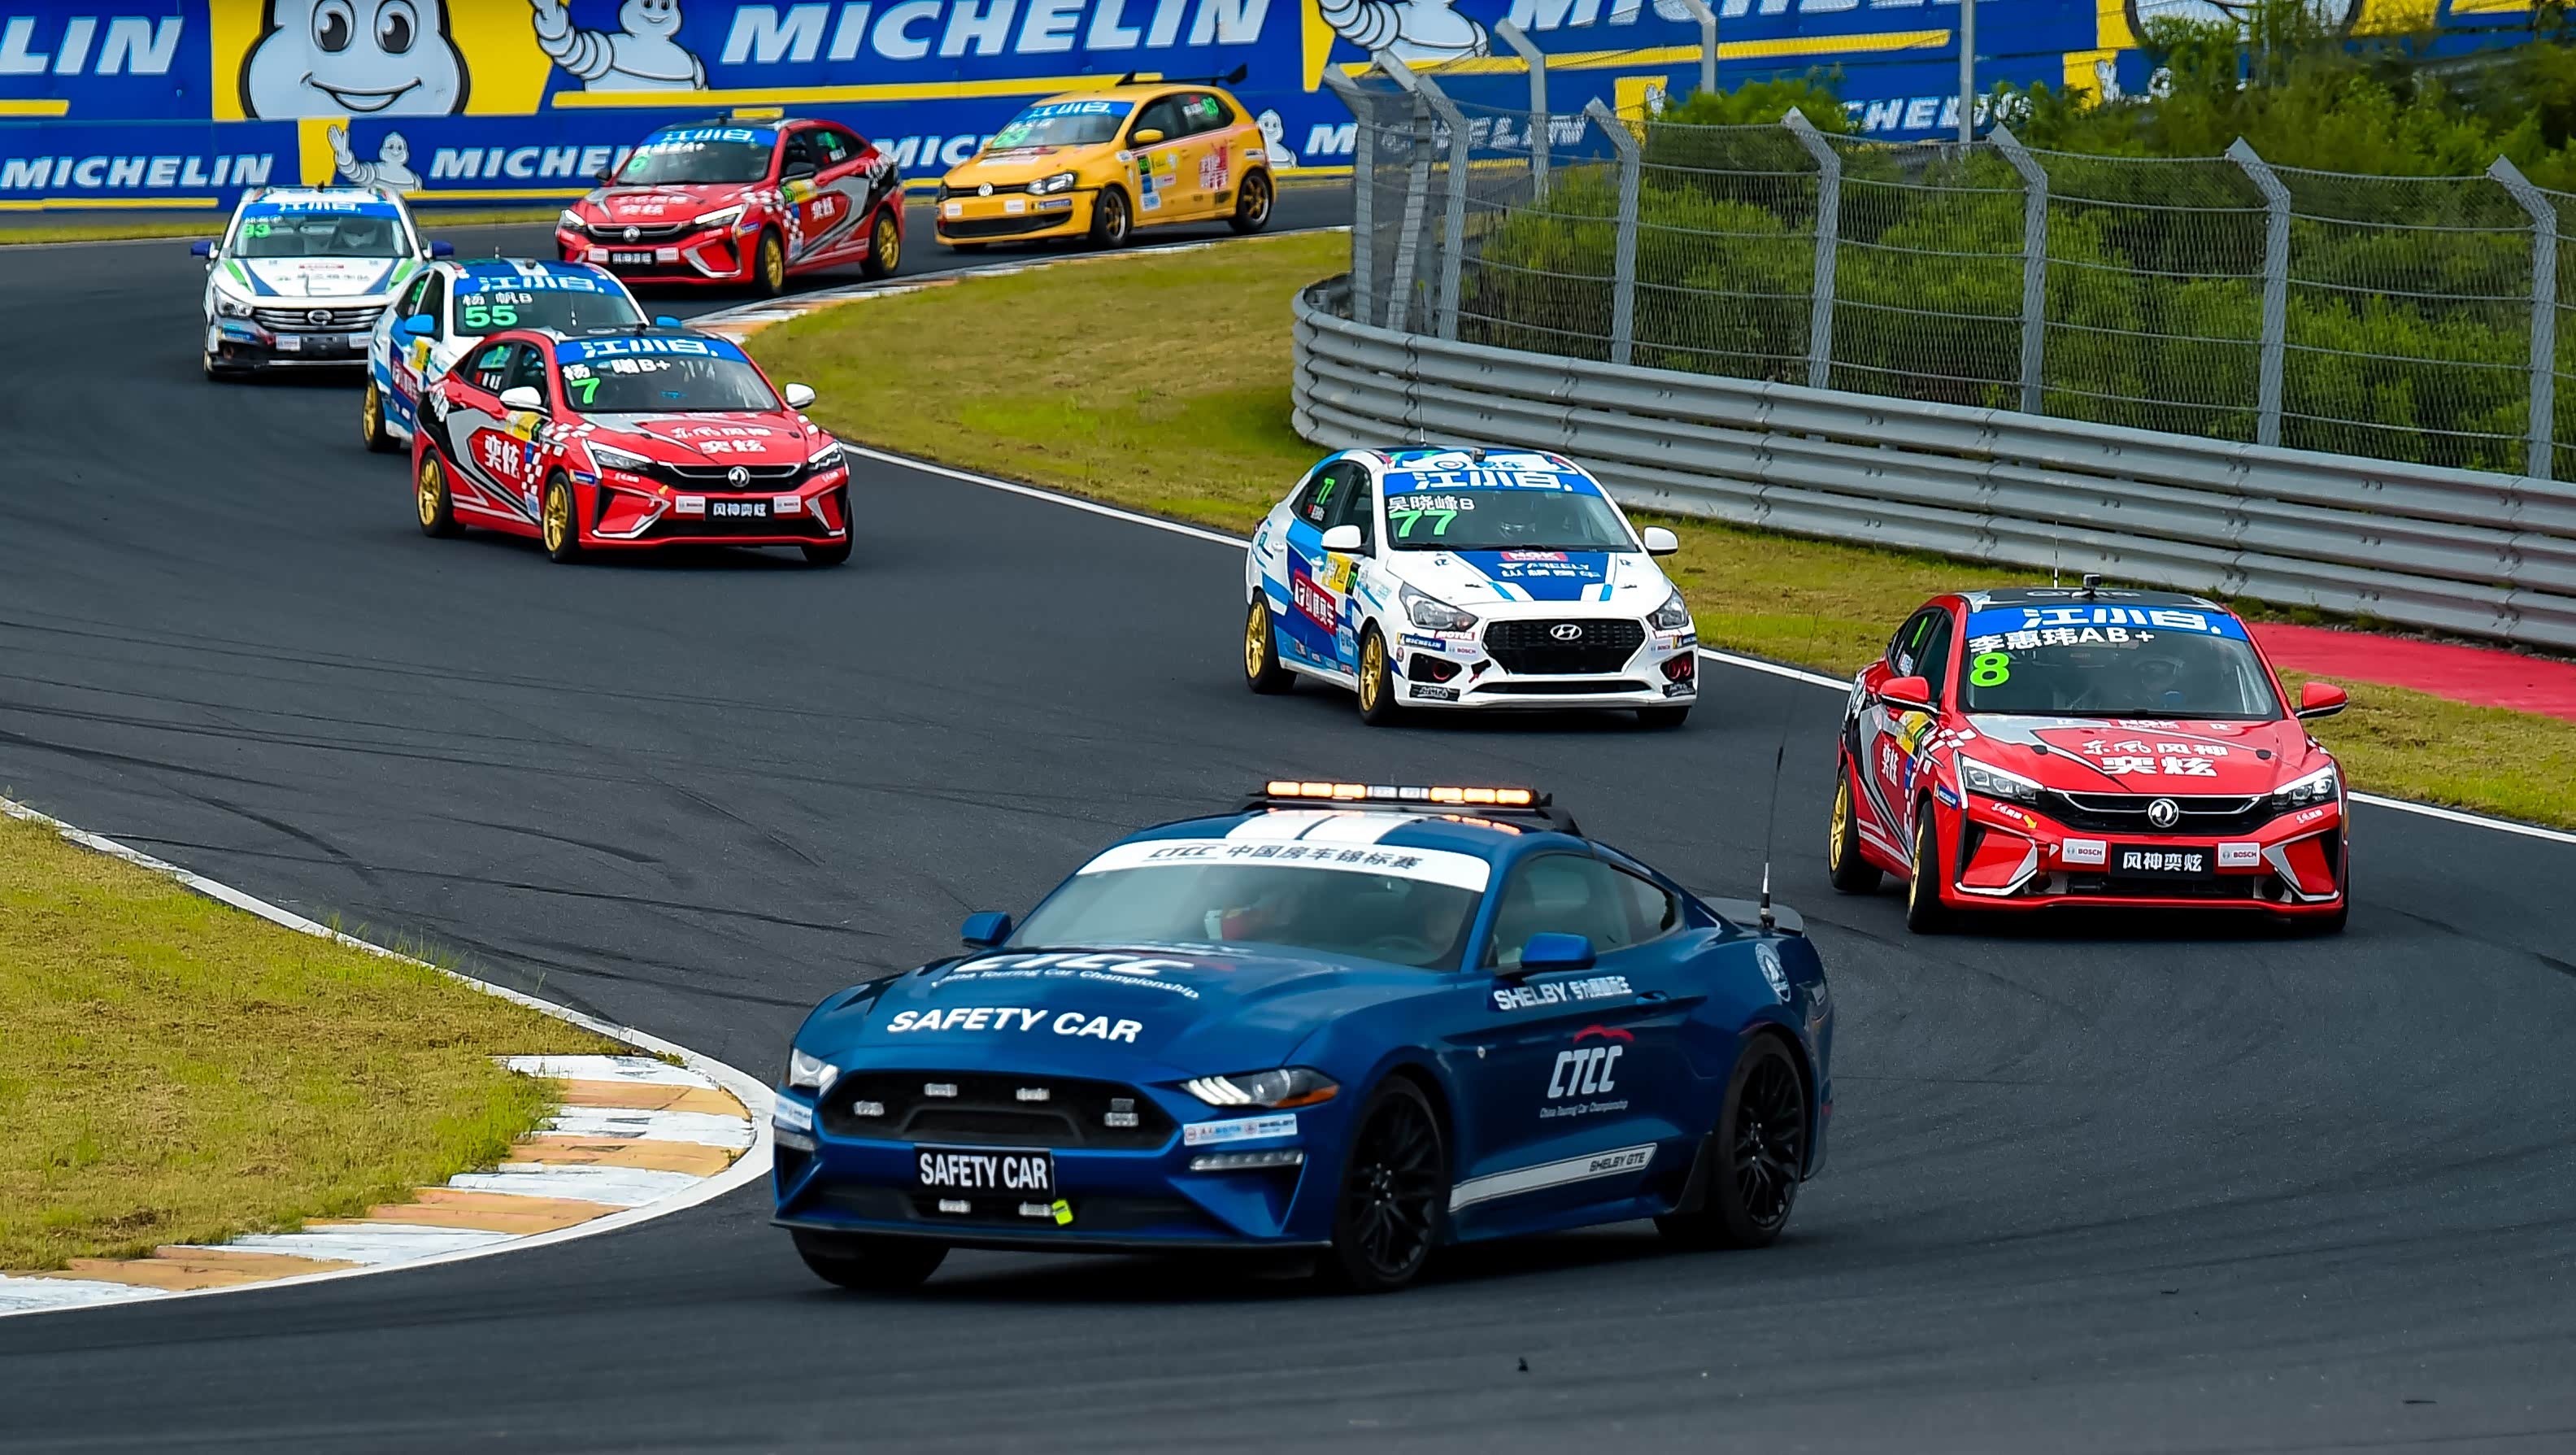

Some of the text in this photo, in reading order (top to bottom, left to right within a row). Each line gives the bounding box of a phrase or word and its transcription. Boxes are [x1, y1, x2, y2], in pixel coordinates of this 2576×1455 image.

[720, 0, 1270, 63] MICHELIN
[2, 154, 274, 189] MICHELIN
[465, 305, 518, 328] 55
[571, 377, 600, 404] 7
[1387, 495, 1476, 512] 吴晓峰B
[1388, 510, 1457, 538] 77
[1405, 637, 1442, 649] MICHELIN
[1969, 651, 2010, 687] 8
[2100, 755, 2218, 778] 奕炫
[1149, 846, 1217, 859] CTCC
[1225, 843, 1424, 870] 中国房车锦标赛
[2078, 847, 2103, 856] BOSCH
[2122, 852, 2204, 873] 风神奕炫
[2233, 850, 2257, 858] BOSCH
[980, 969, 1039, 978] Touring
[1044, 968, 1077, 977] Car
[1079, 969, 1200, 1000] Championship
[1494, 981, 1568, 1010] SHELBY
[887, 1007, 1142, 1043] SAFETY CAR
[1547, 1045, 1623, 1098] CTCC
[920, 1152, 1048, 1190] SAFETY CAR
[1589, 1151, 1647, 1173] SHELBY GTE
